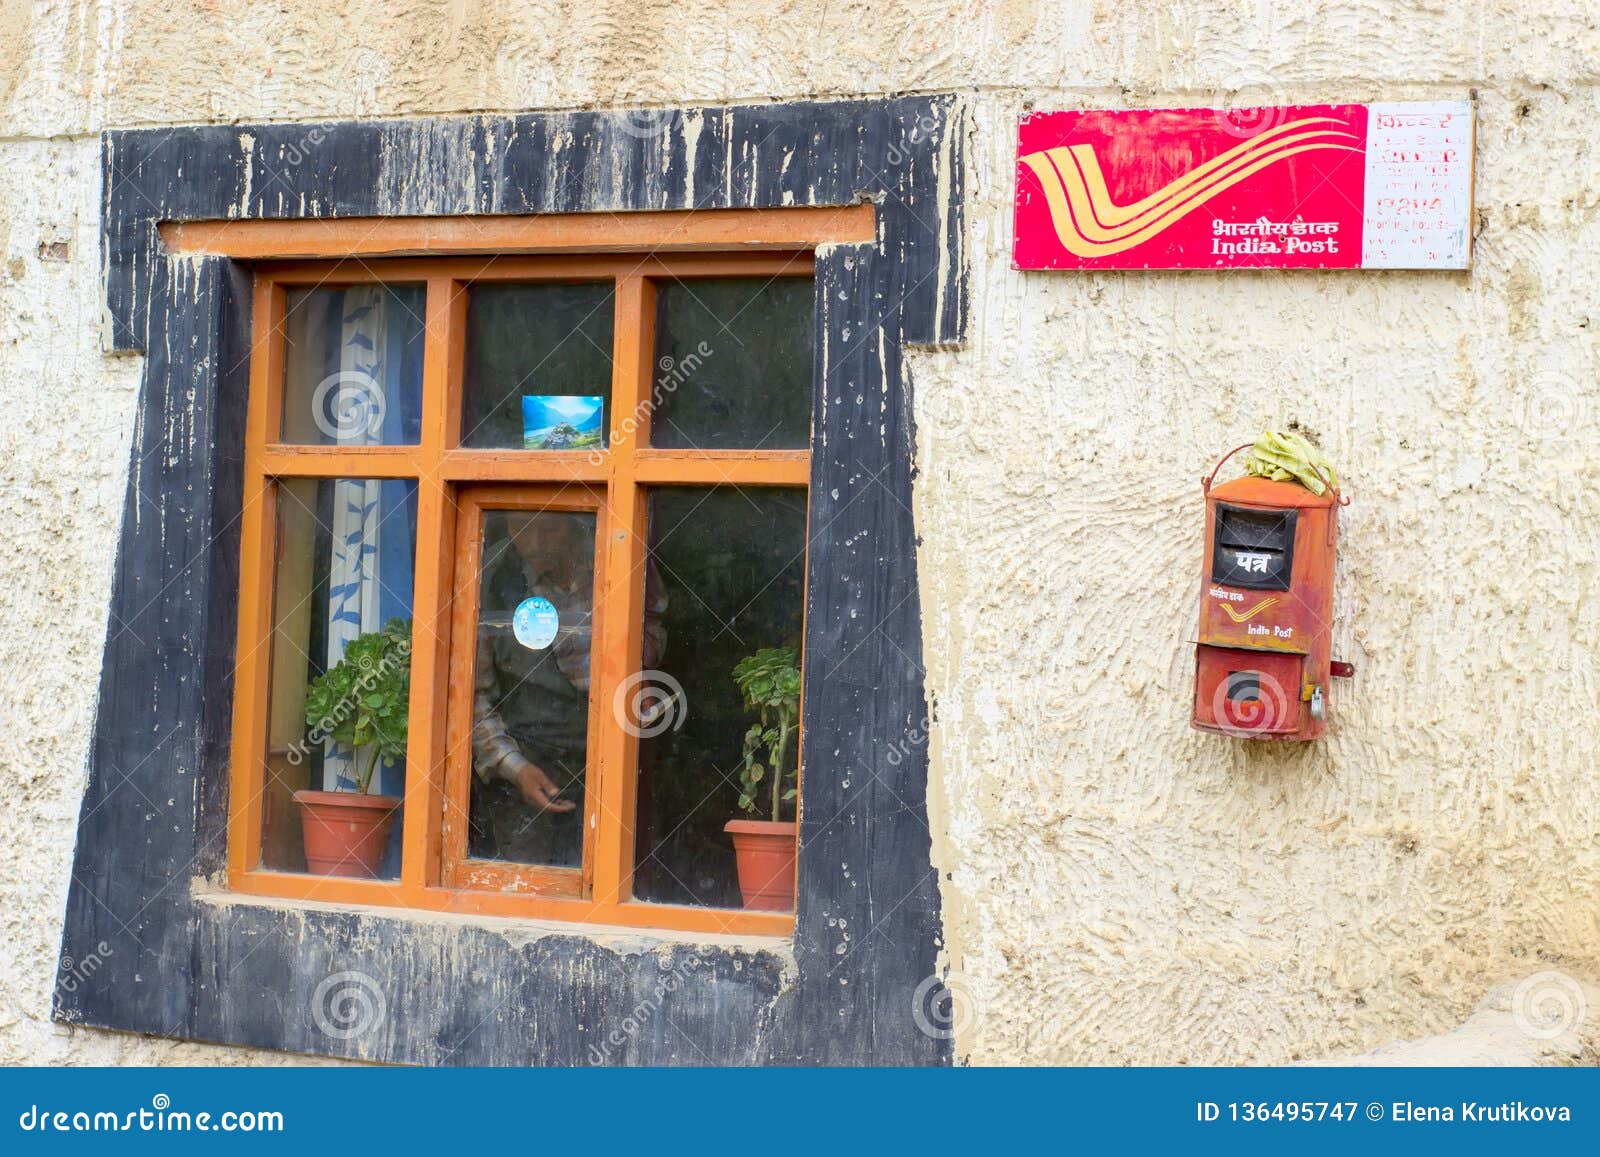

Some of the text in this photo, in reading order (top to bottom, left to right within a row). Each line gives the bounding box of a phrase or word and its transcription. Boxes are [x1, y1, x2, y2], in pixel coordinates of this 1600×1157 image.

[1212, 216, 1288, 236] भारतीय
[1210, 237, 1339, 254] India Post
[1235, 552, 1272, 573] पत्र
[1247, 624, 1293, 638] India Post
